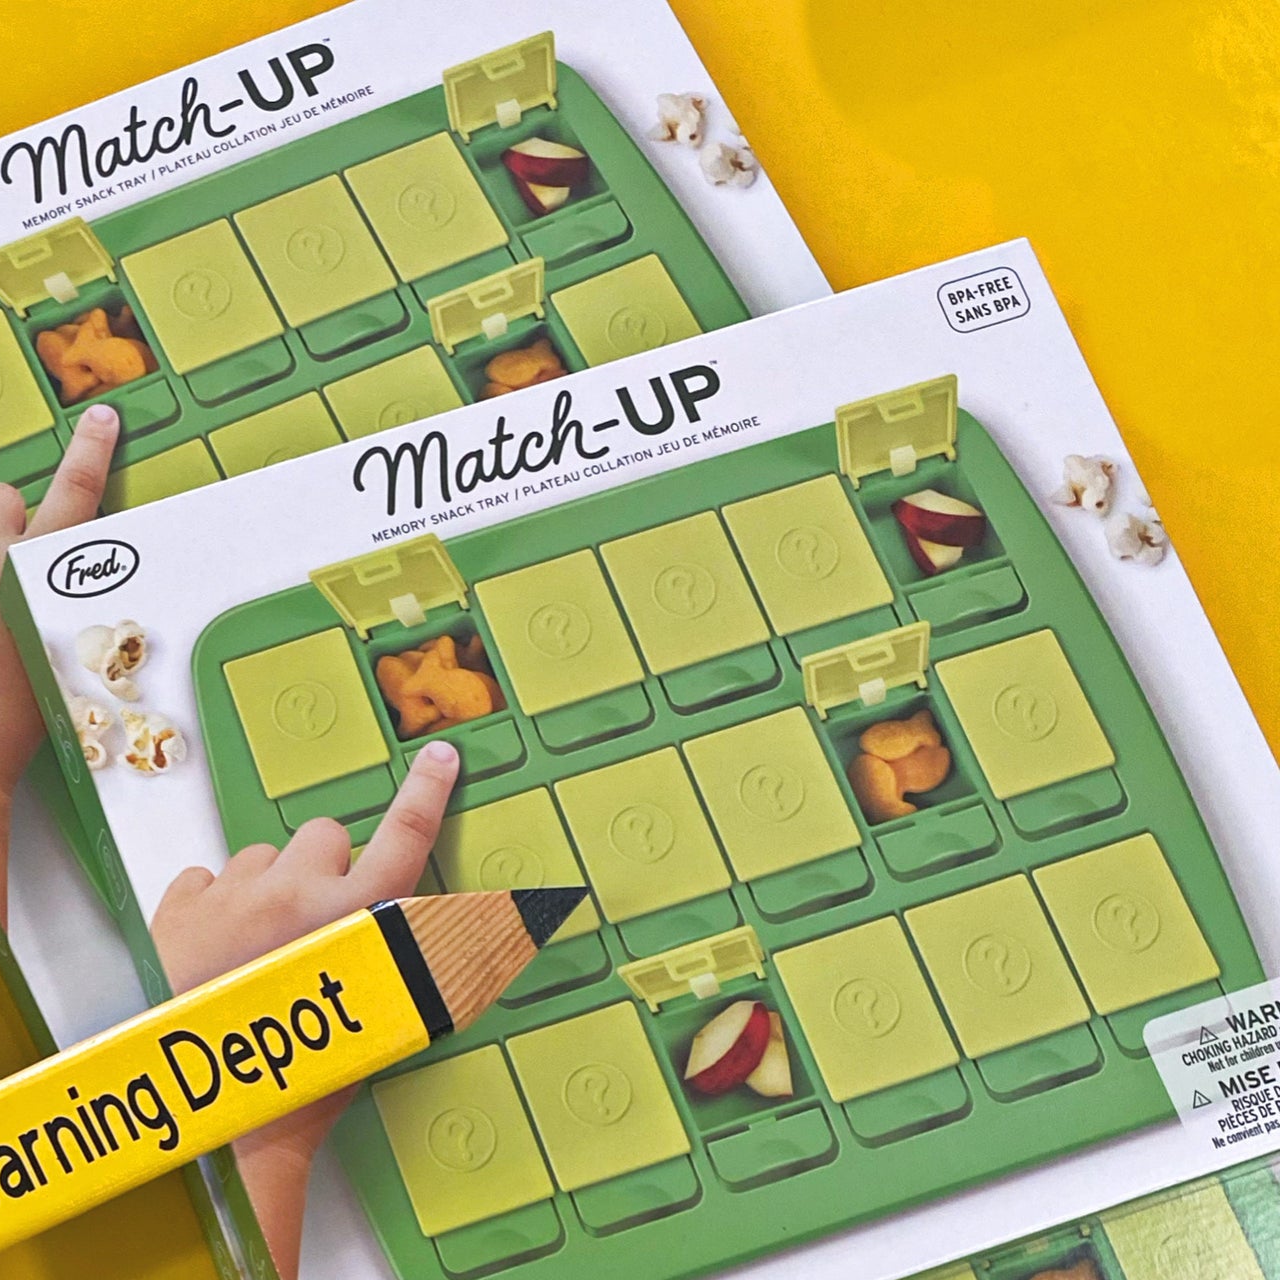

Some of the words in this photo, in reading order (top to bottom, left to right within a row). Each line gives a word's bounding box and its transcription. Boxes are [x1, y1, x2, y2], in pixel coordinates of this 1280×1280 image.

[23, 204, 70, 228] MEMORY
[76, 188, 115, 208] SNACK
[118, 174, 145, 190] TRAY
[159, 150, 210, 174] PLATEAU
[214, 124, 276, 153] COLLATION
[282, 115, 301, 128] JEU
[303, 107, 318, 118] DE
[322, 86, 373, 109] MÉMOIRE
[947, 276, 1013, 305] BPA-FREE
[955, 303, 992, 324] SANS
[993, 294, 1022, 312] BPA
[372, 518, 425, 542] MEMORY
[431, 505, 474, 524] SNACK
[477, 493, 508, 509] TRAY
[523, 472, 579, 495] PLATEAU
[584, 450, 652, 477] COLLATION
[658, 441, 680, 455] JEU
[683, 435, 699, 447] DE
[703, 417, 760, 440] MÉMOIRE
[66, 547, 120, 589] Fred
[158, 971, 365, 1114] Depot
[1182, 1041, 1232, 1067] CHOKING
[1232, 1025, 1278, 1049] HAZARD
[1207, 1061, 1226, 1073] Not
[1226, 1055, 1239, 1068] for
[1240, 1044, 1276, 1063] children
[1218, 1065, 1277, 1098] MISE
[1231, 1088, 1275, 1113] RISQUE
[1218, 1108, 1259, 1133] PIÈCES
[1258, 1102, 1276, 1119] DE
[1212, 1135, 1226, 1149] Ne
[1226, 1122, 1265, 1143] convient
